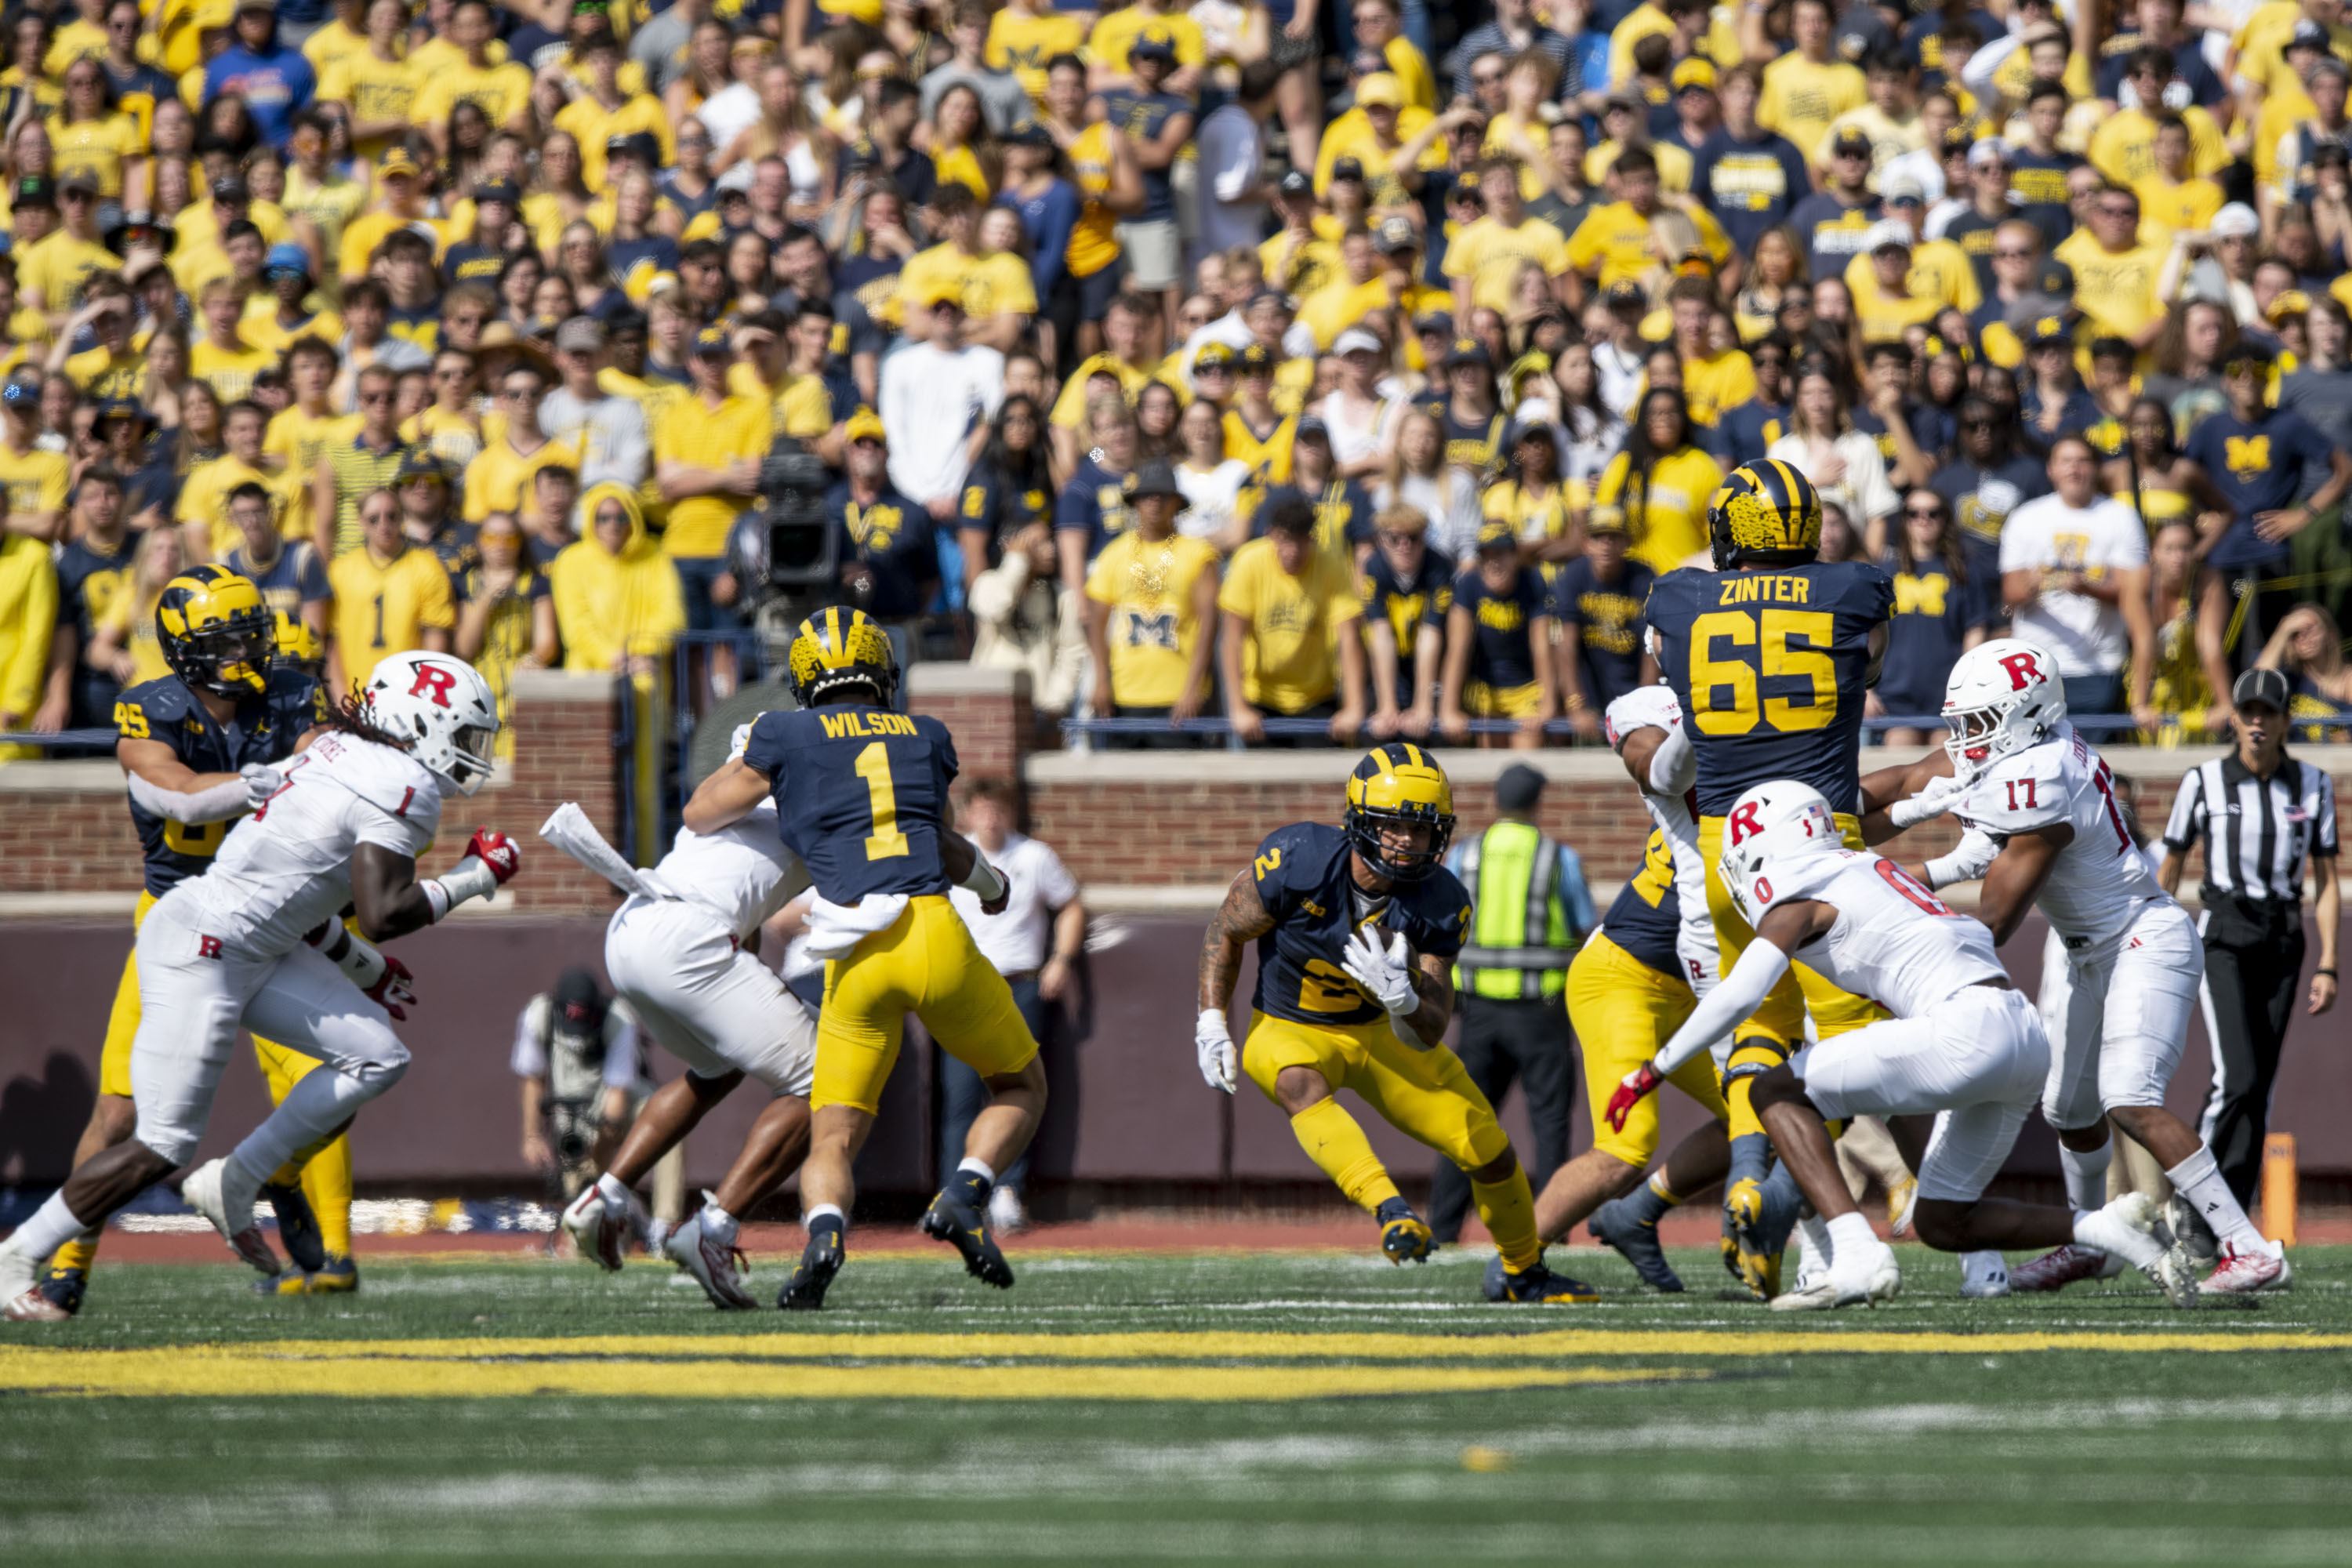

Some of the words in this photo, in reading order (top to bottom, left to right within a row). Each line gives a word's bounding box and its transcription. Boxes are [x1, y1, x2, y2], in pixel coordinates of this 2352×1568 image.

[2223, 434, 2272, 474] M
[1719, 575, 1809, 606] ZINTER
[1893, 571, 1951, 619] M
[371, 593, 387, 648] 1
[1129, 613, 1174, 648] M
[408, 662, 458, 708] R
[1690, 608, 1838, 735] 65
[1998, 652, 2047, 692] R
[819, 712, 918, 739] WILSON
[395, 785, 416, 818] 1
[854, 741, 909, 861] 1
[2005, 778, 2038, 811] 17
[1730, 800, 1765, 848] R
[1254, 848, 1281, 882] 2
[1754, 876, 1773, 904] 0
[1874, 858, 1962, 917] 0
[1458, 904, 1473, 946] 2
[198, 935, 223, 960] R
[1298, 958, 1363, 1014] 2
[1688, 959, 1708, 980] R
